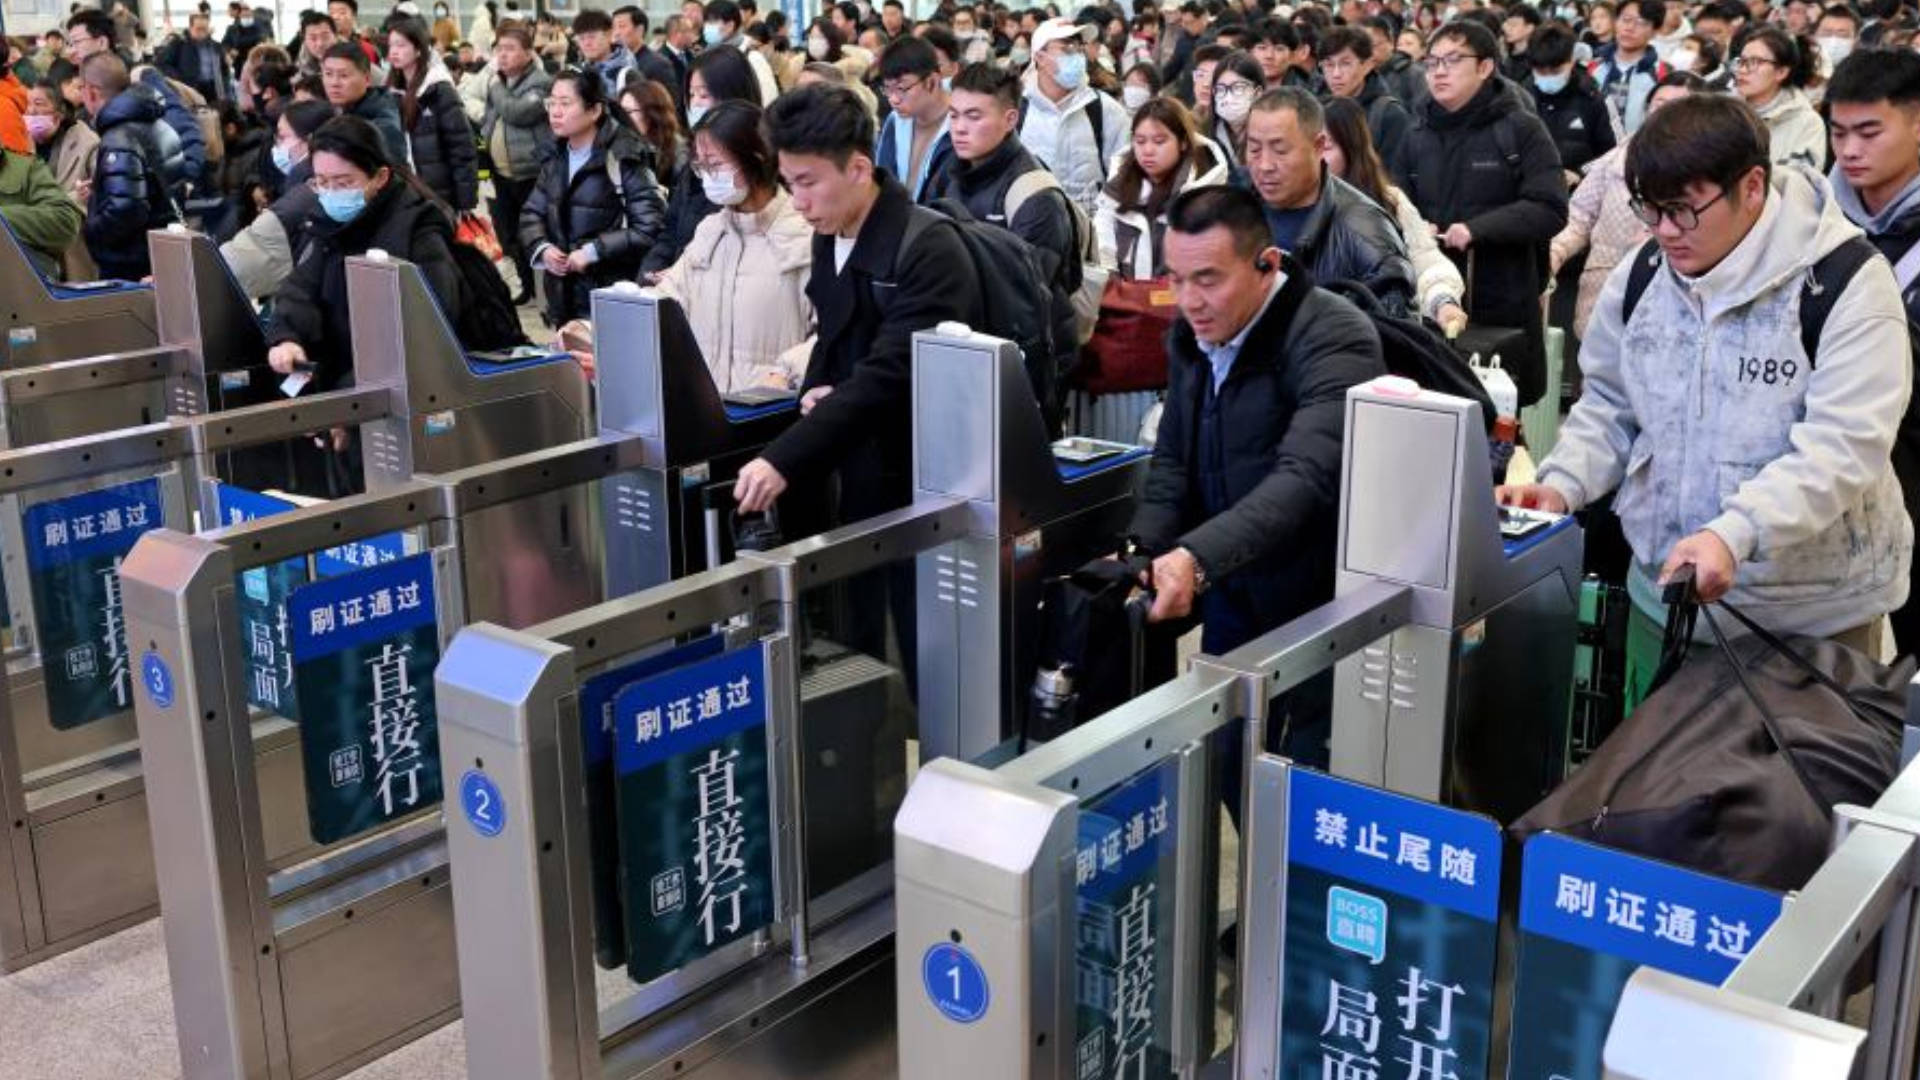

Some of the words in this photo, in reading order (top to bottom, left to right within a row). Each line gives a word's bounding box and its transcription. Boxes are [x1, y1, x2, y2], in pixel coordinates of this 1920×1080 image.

[1738, 357, 1798, 386] 1989
[44, 501, 149, 546] 刷证通过
[310, 580, 421, 636] 刷证通过
[152, 667, 164, 693] 3
[364, 644, 423, 816] 直接行
[635, 675, 751, 743] 刷证通过
[475, 788, 491, 821] 2
[689, 749, 748, 946] 直接行
[1076, 797, 1168, 886] 刷证通过
[1314, 808, 1476, 885] 禁止尾随
[1336, 897, 1378, 924] BOSS
[1555, 873, 1751, 961] 刷证通过
[946, 965, 960, 1001] 1
